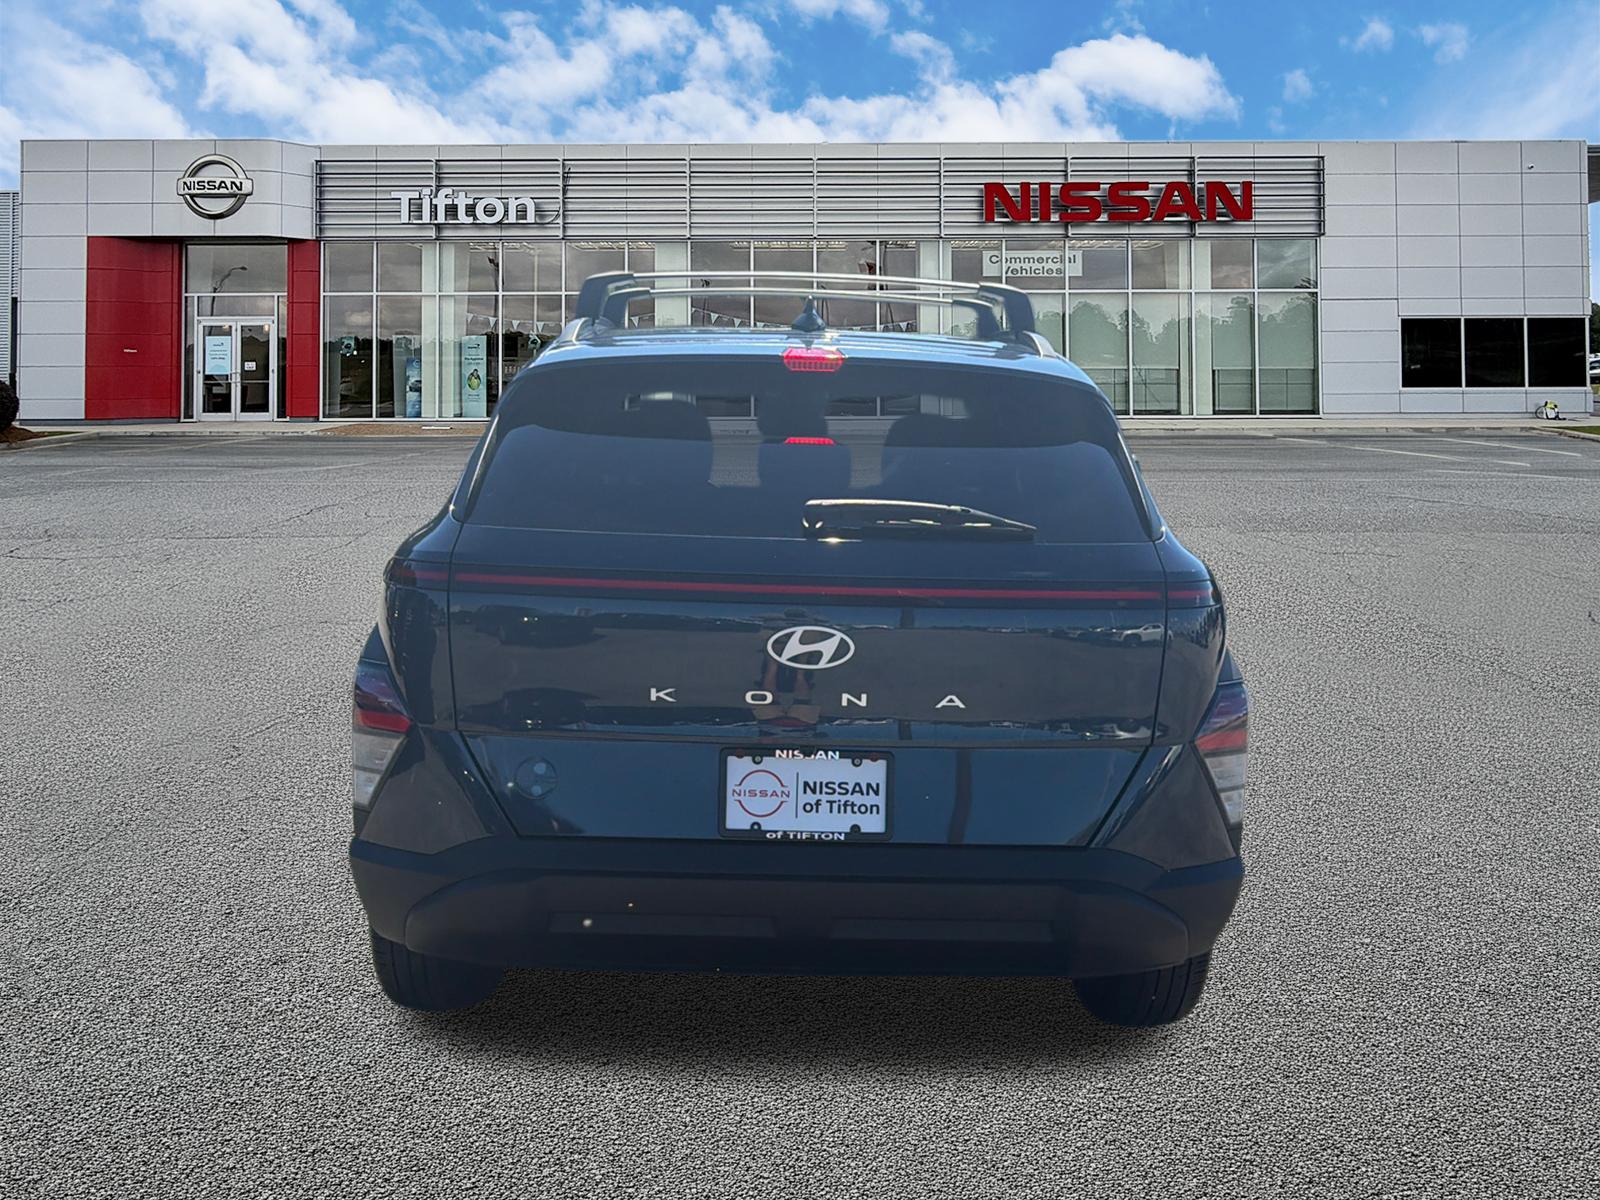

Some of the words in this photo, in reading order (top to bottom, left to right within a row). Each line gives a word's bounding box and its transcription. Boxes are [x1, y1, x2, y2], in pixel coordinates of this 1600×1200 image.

[182, 180, 243, 191] NISSAN
[391, 188, 536, 224] Tifton
[983, 181, 1253, 222] NISSAN
[650, 687, 966, 708] KONA
[731, 788, 791, 799] NISSAN
[803, 781, 880, 796] NISSAN
[802, 800, 822, 814] of
[826, 800, 880, 815] Tifton
[766, 831, 783, 839] of
[787, 832, 845, 841] TIFTON
